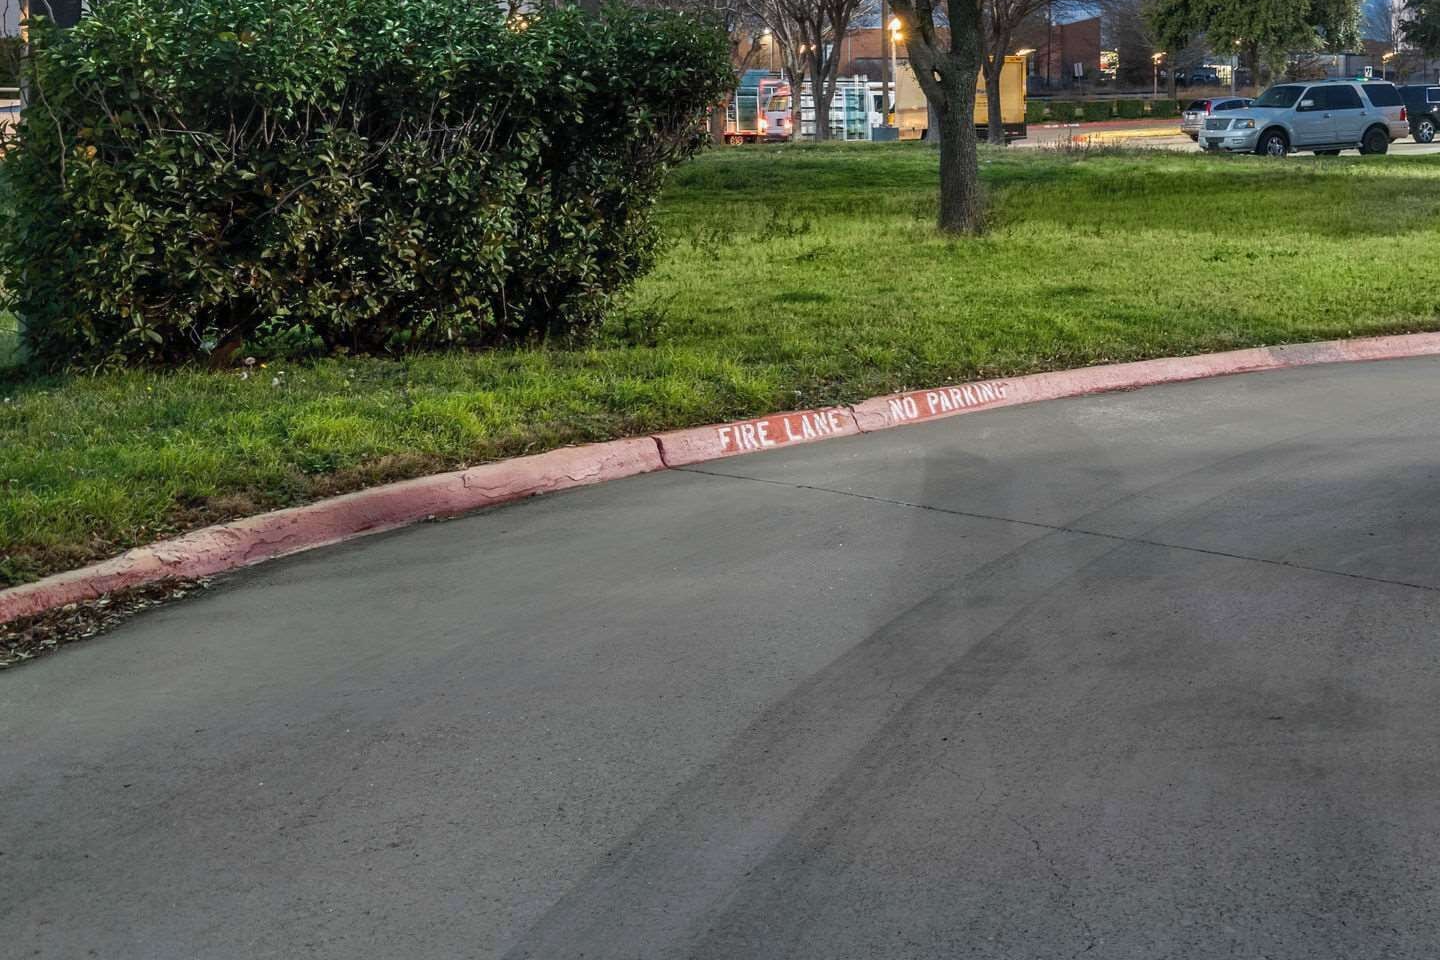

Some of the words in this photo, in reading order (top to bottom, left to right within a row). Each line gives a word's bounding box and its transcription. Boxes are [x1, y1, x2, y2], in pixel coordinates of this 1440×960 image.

[717, 420, 776, 450] FIRE
[783, 409, 847, 442] LANE
[887, 396, 918, 422] NO
[927, 382, 1008, 414] PARKING
